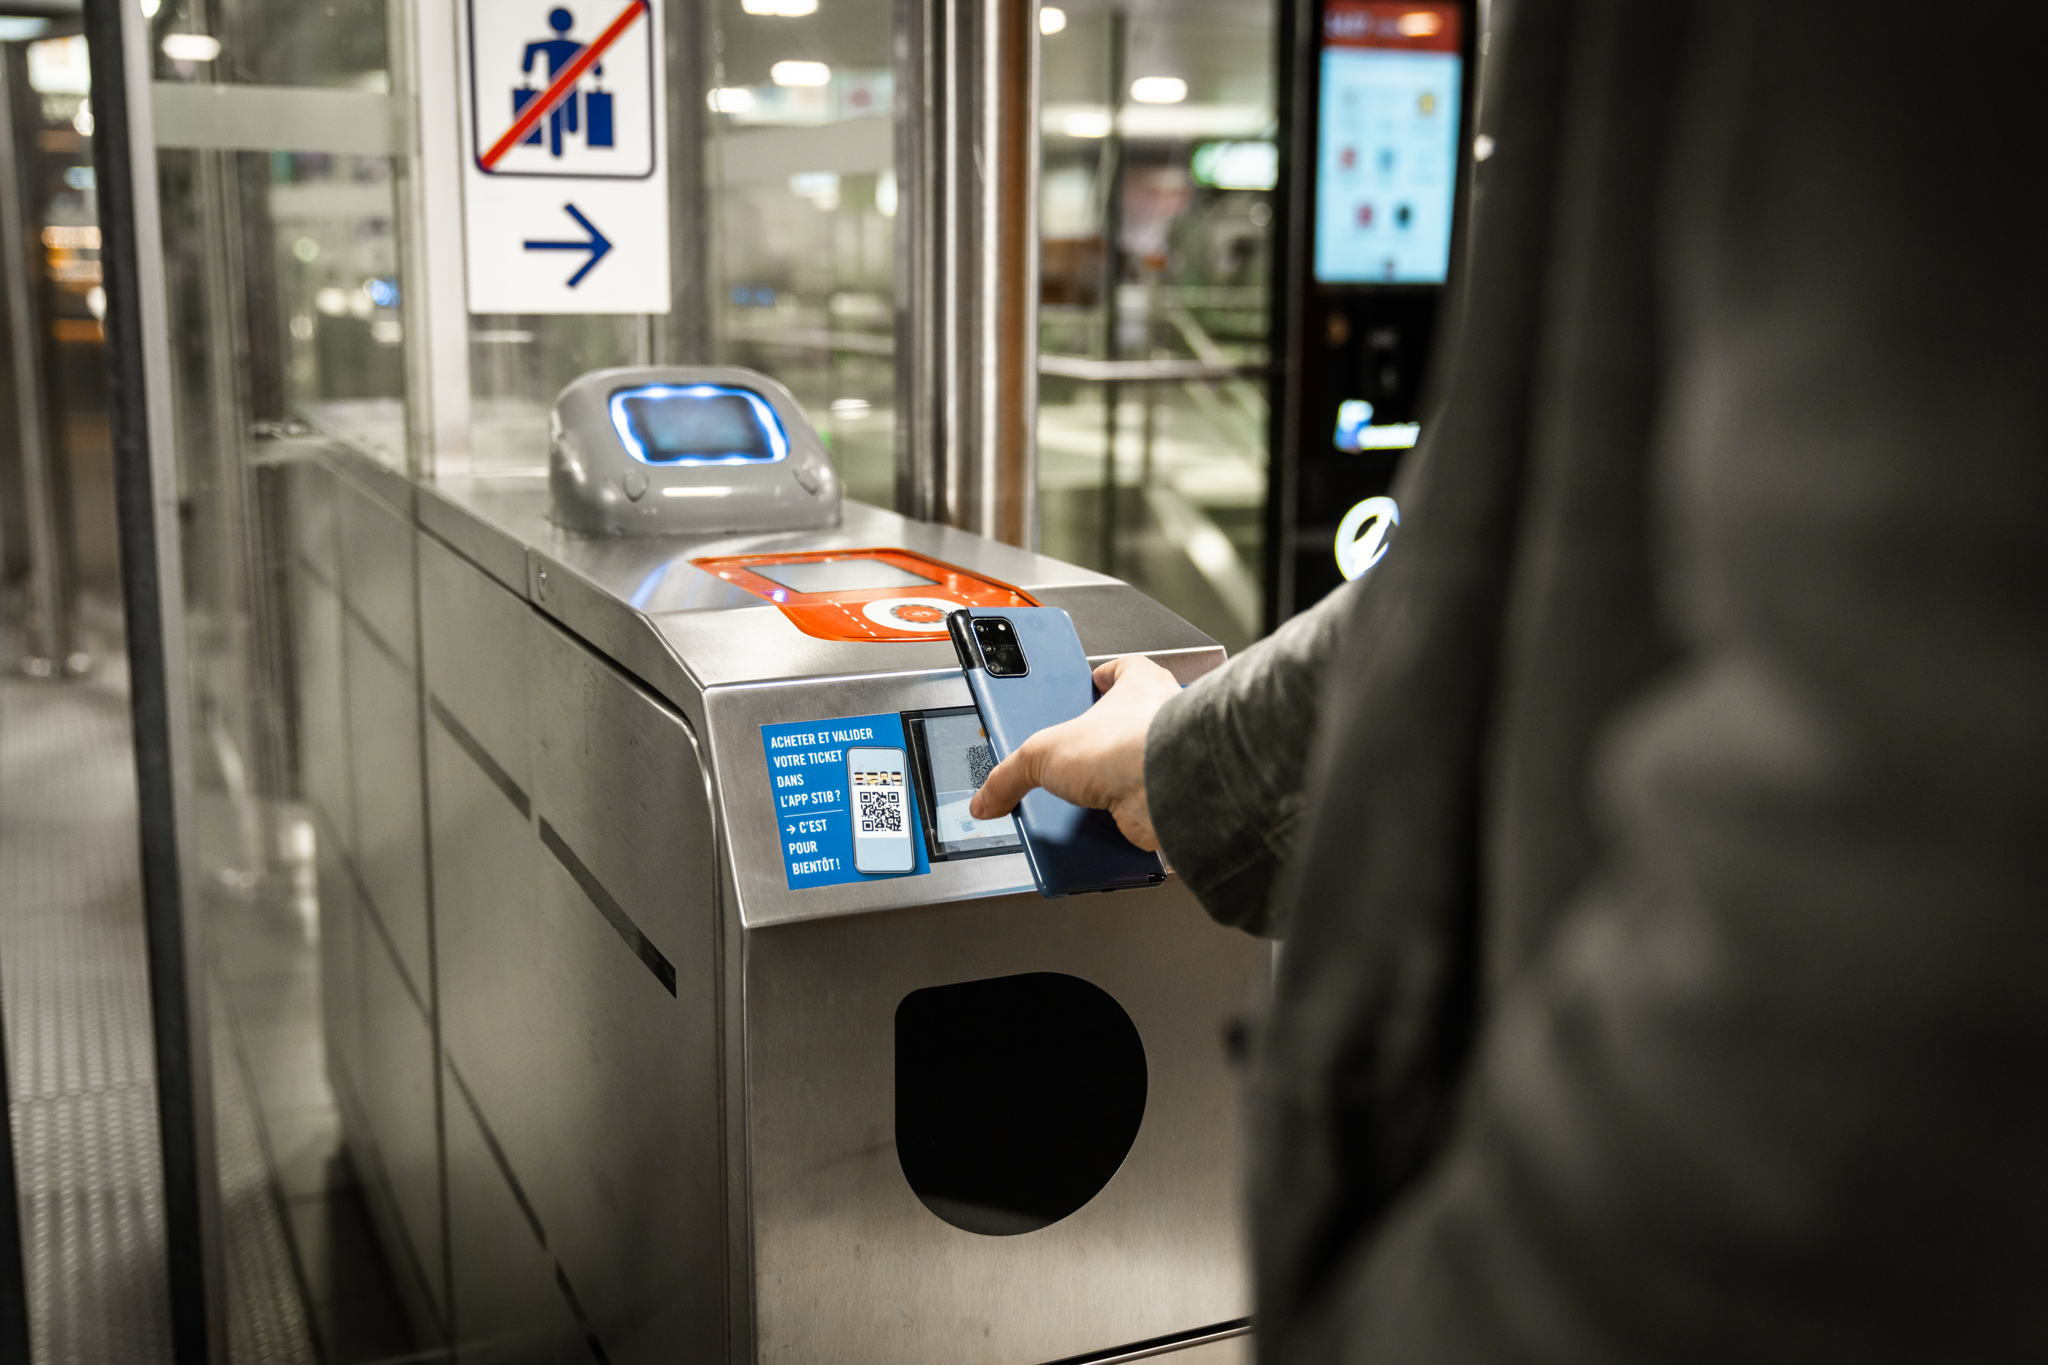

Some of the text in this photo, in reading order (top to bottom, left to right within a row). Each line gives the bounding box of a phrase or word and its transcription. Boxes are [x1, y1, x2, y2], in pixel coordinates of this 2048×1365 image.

[772, 728, 873, 748] ACHETER ET VALIDER
[774, 750, 842, 767] VOTRE TICKET
[777, 774, 804, 787] DANS
[781, 794, 808, 807] L'APP
[799, 819, 826, 833] C'EST
[789, 841, 817, 854] POUR
